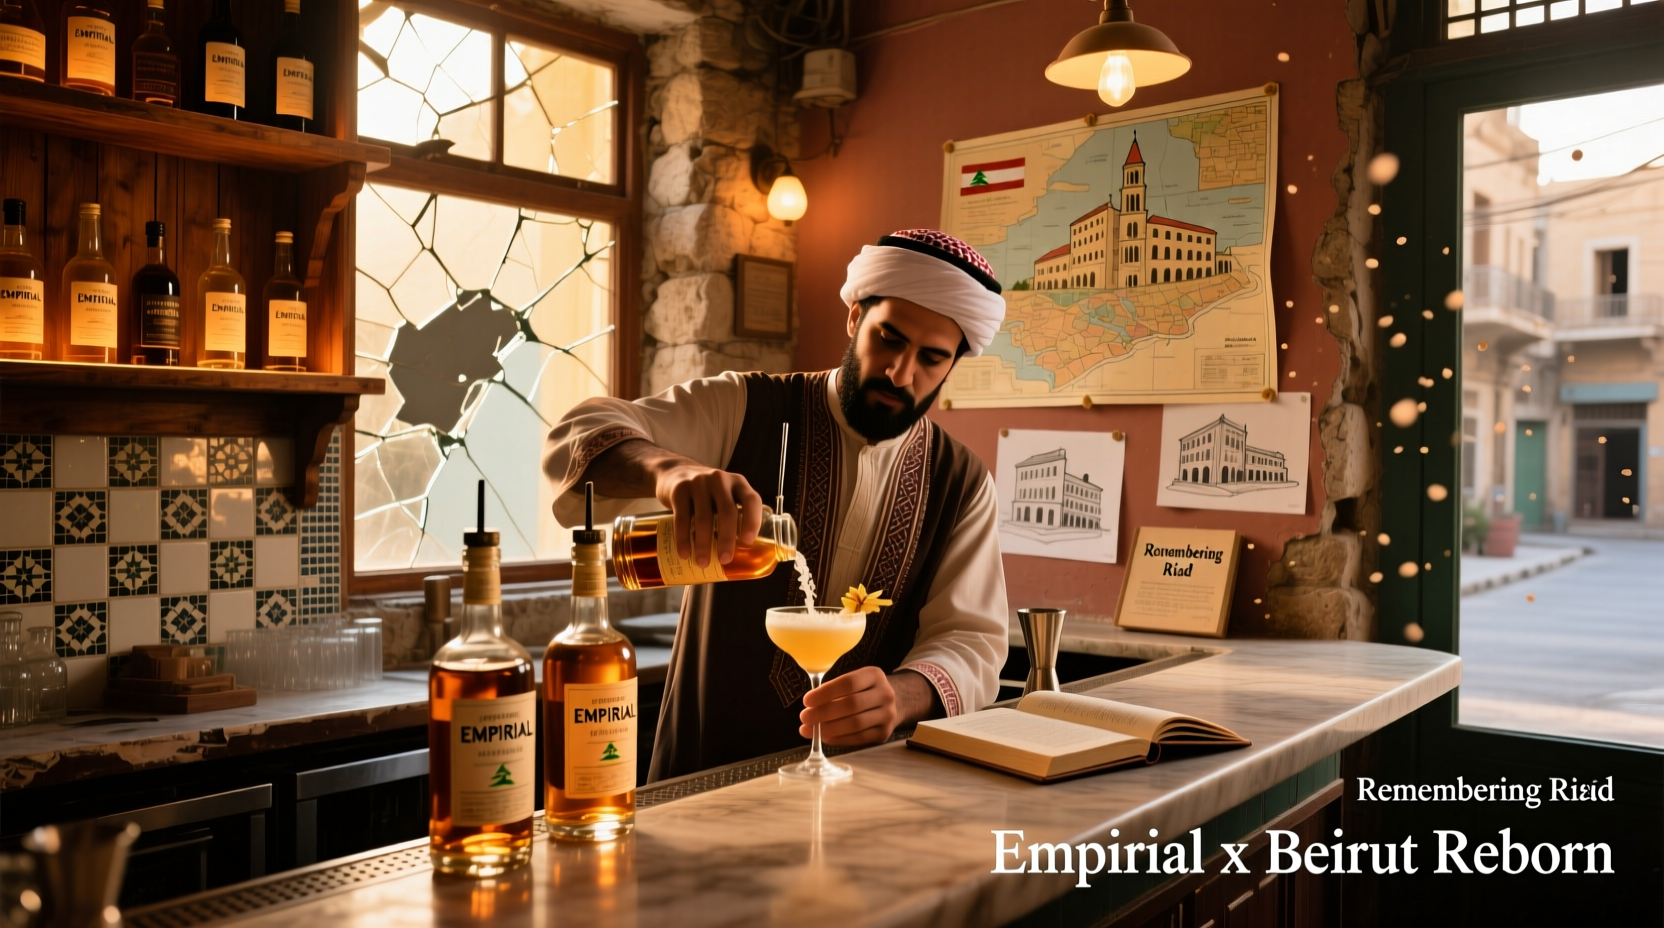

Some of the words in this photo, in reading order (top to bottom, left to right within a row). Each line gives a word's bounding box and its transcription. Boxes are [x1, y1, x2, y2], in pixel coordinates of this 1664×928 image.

[1163, 562, 1193, 577] Riad
[574, 703, 636, 724] EMPIRIAL
[460, 720, 533, 744] EMPIRIAL
